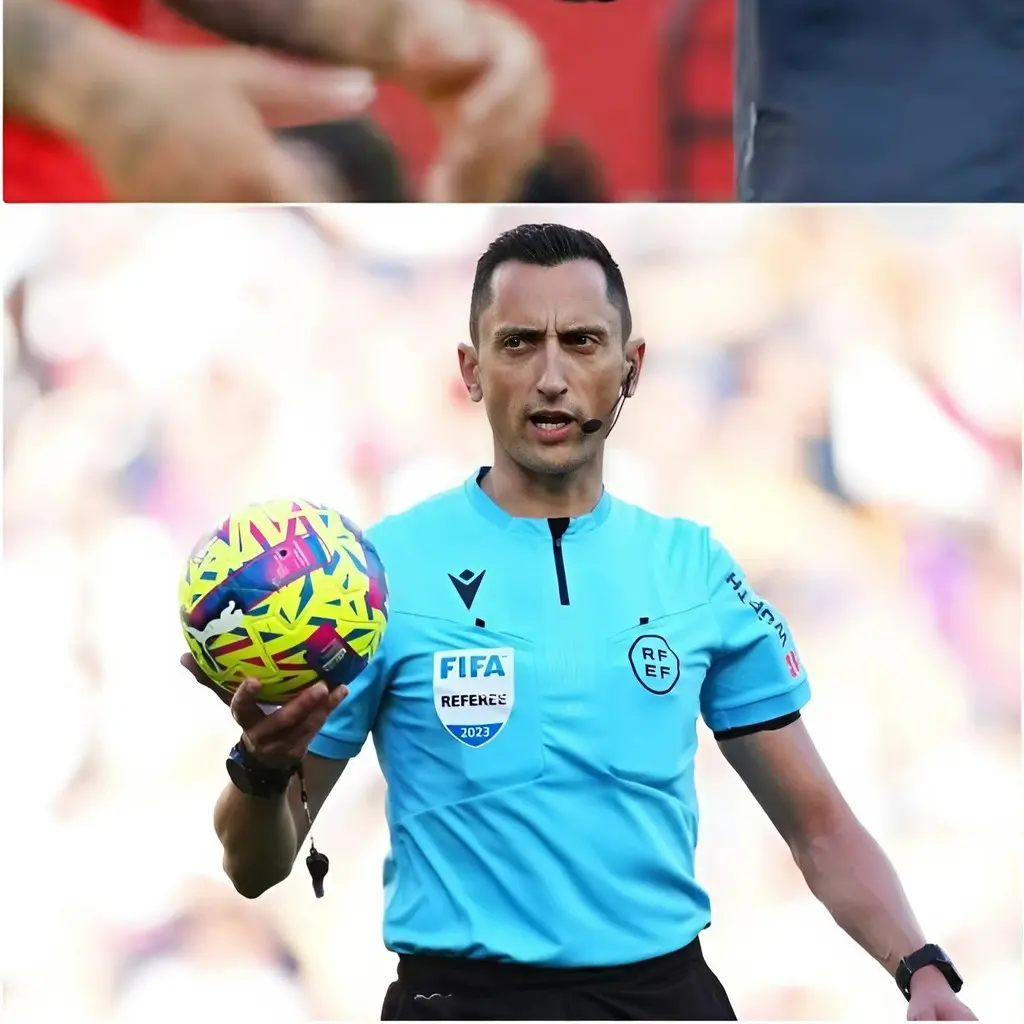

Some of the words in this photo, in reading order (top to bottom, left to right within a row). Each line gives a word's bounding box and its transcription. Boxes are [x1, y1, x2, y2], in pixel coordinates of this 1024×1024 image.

[440, 655, 505, 679] FIFA
[441, 694, 507, 707] REFEREE
[460, 727, 490, 738] 2023
